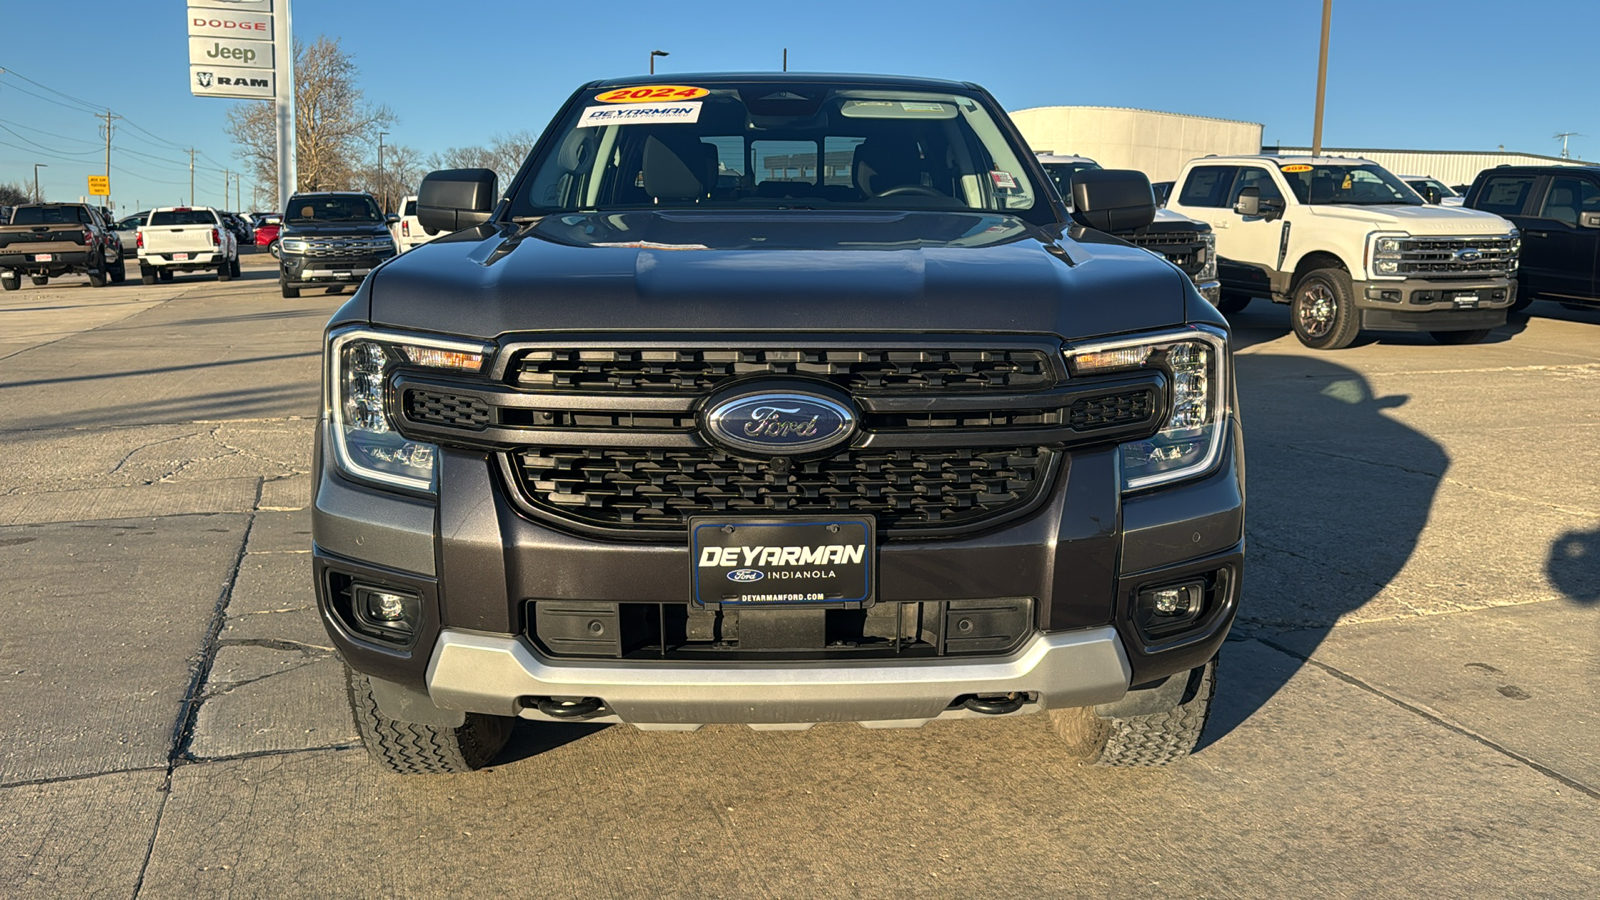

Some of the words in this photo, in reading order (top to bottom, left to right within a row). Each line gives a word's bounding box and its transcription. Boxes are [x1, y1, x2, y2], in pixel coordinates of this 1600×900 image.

[193, 18, 266, 31] DODGE
[206, 43, 256, 63] Jeep
[217, 77, 268, 87] RAM
[605, 88, 699, 100] 2024
[589, 107, 694, 118] DEYARMAN
[743, 406, 819, 437] Ford
[698, 544, 866, 567] DEYARMAN
[767, 570, 836, 579] INDIANOLA
[741, 593, 825, 602] DEYARMANFORD.COM
